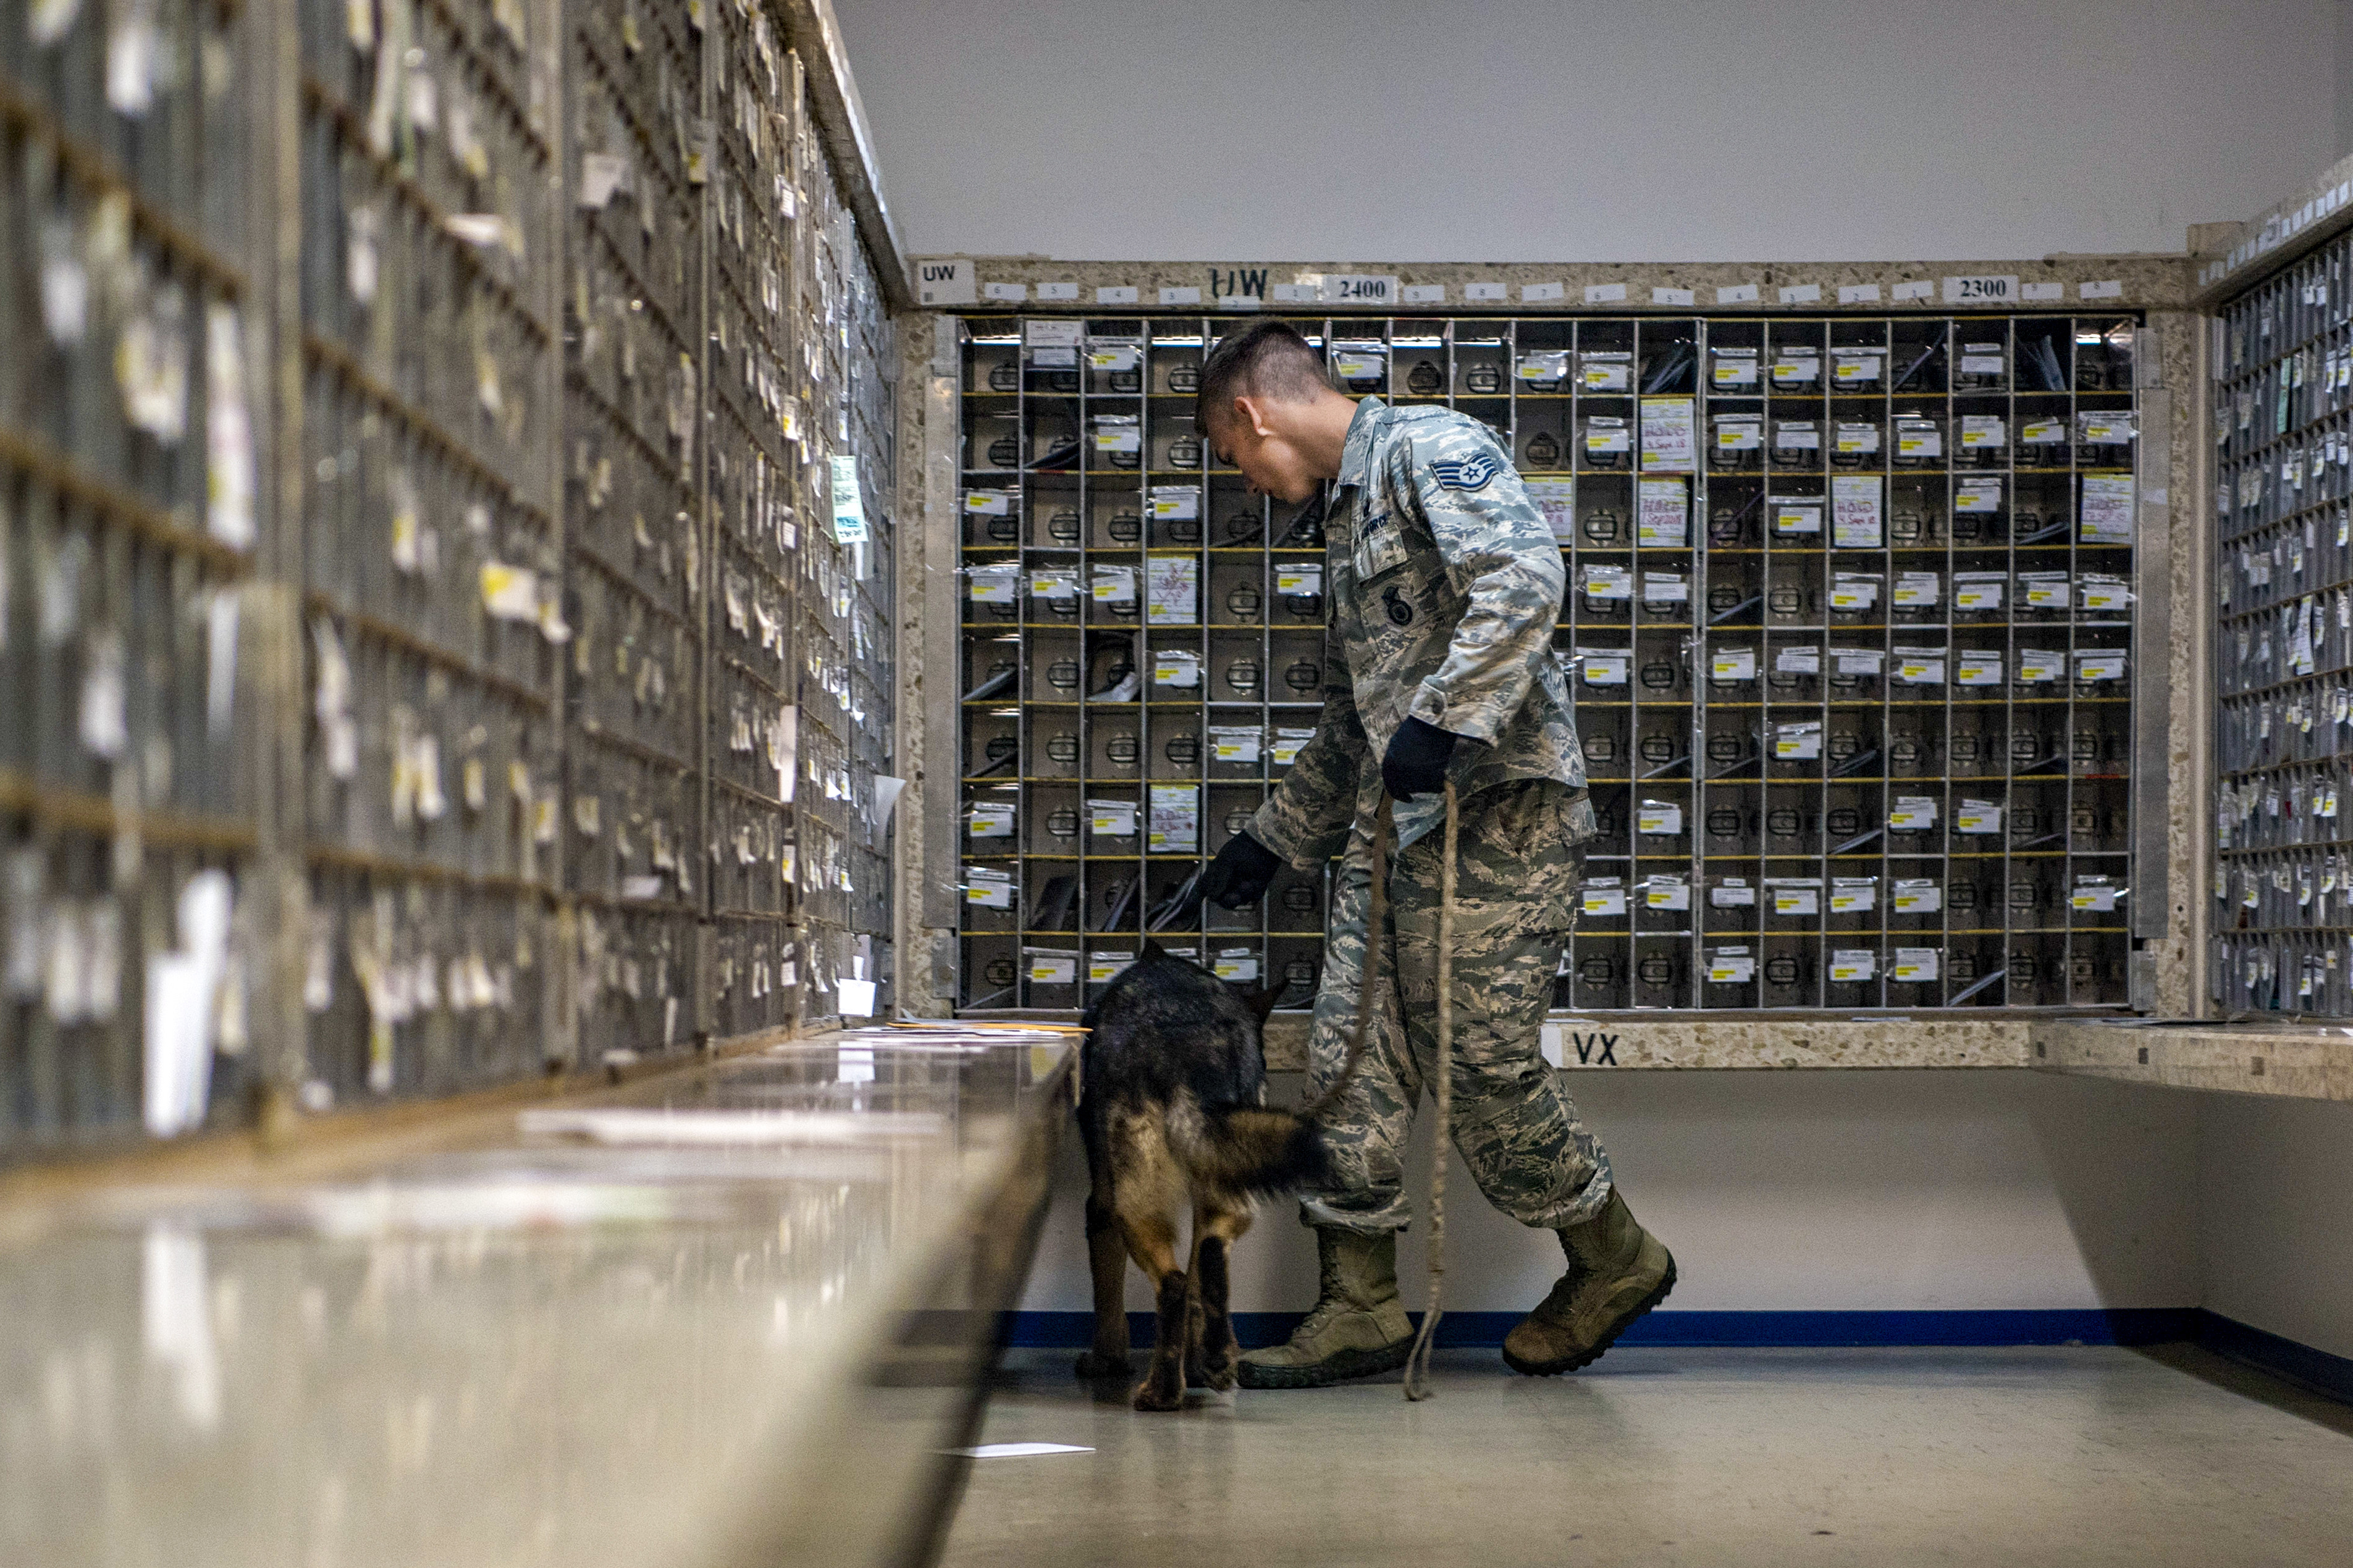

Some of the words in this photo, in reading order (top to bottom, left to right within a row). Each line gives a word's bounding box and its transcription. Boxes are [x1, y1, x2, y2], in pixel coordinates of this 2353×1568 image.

[923, 265, 956, 282] UW
[1209, 269, 1268, 301] UW
[1339, 280, 1386, 298] 2400
[1960, 279, 2007, 297] 2300
[1572, 1032, 1620, 1067] VX
